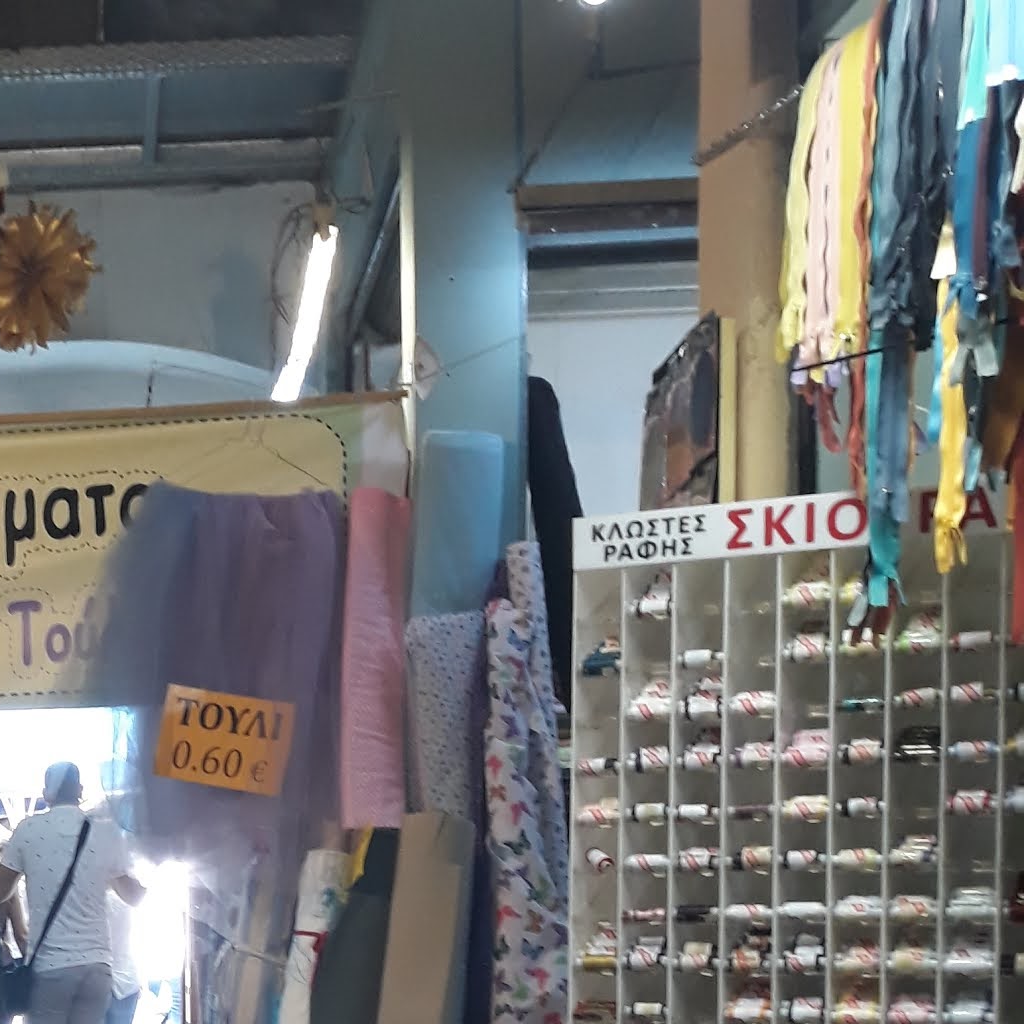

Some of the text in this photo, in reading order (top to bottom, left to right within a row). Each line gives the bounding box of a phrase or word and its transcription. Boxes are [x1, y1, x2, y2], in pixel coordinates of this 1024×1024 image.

[591, 513, 708, 543] ΚΛΩΣΤΕΣ
[603, 537, 693, 562] ΡΑΦΗΣ
[178, 697, 283, 741] ΤΟΥΛΙ
[172, 740, 268, 783] 0.60 €
